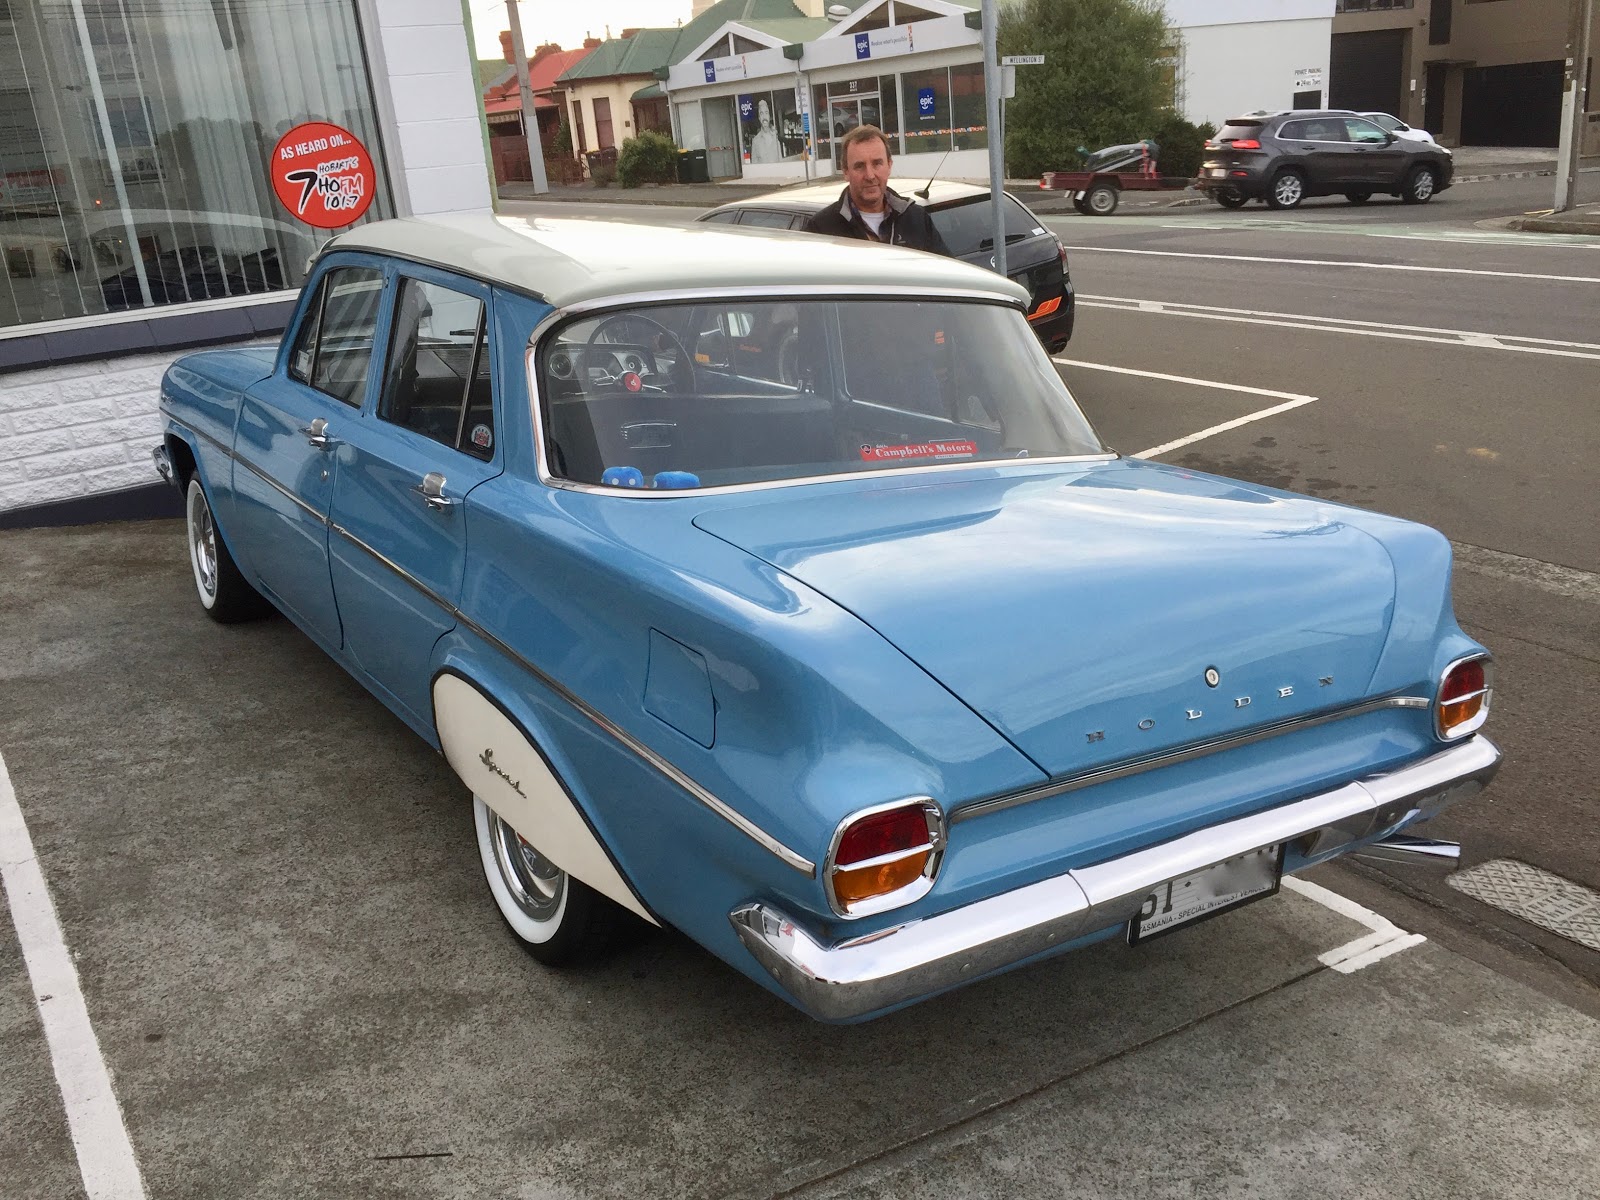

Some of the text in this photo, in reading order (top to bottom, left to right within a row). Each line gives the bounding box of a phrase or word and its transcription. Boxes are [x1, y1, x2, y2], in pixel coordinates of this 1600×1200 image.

[857, 40, 868, 51] epic
[741, 101, 752, 112] epic
[920, 95, 933, 107] epic
[281, 146, 294, 160] AS
[295, 138, 328, 157] HEARD
[318, 156, 358, 173] HOBART'S
[326, 195, 358, 208] 101.7
[875, 444, 934, 458] Campbell's
[936, 443, 972, 453] Motors
[1178, 904, 1206, 920] SPECIAL
[1528, 892, 1588, 918] WATER METER
